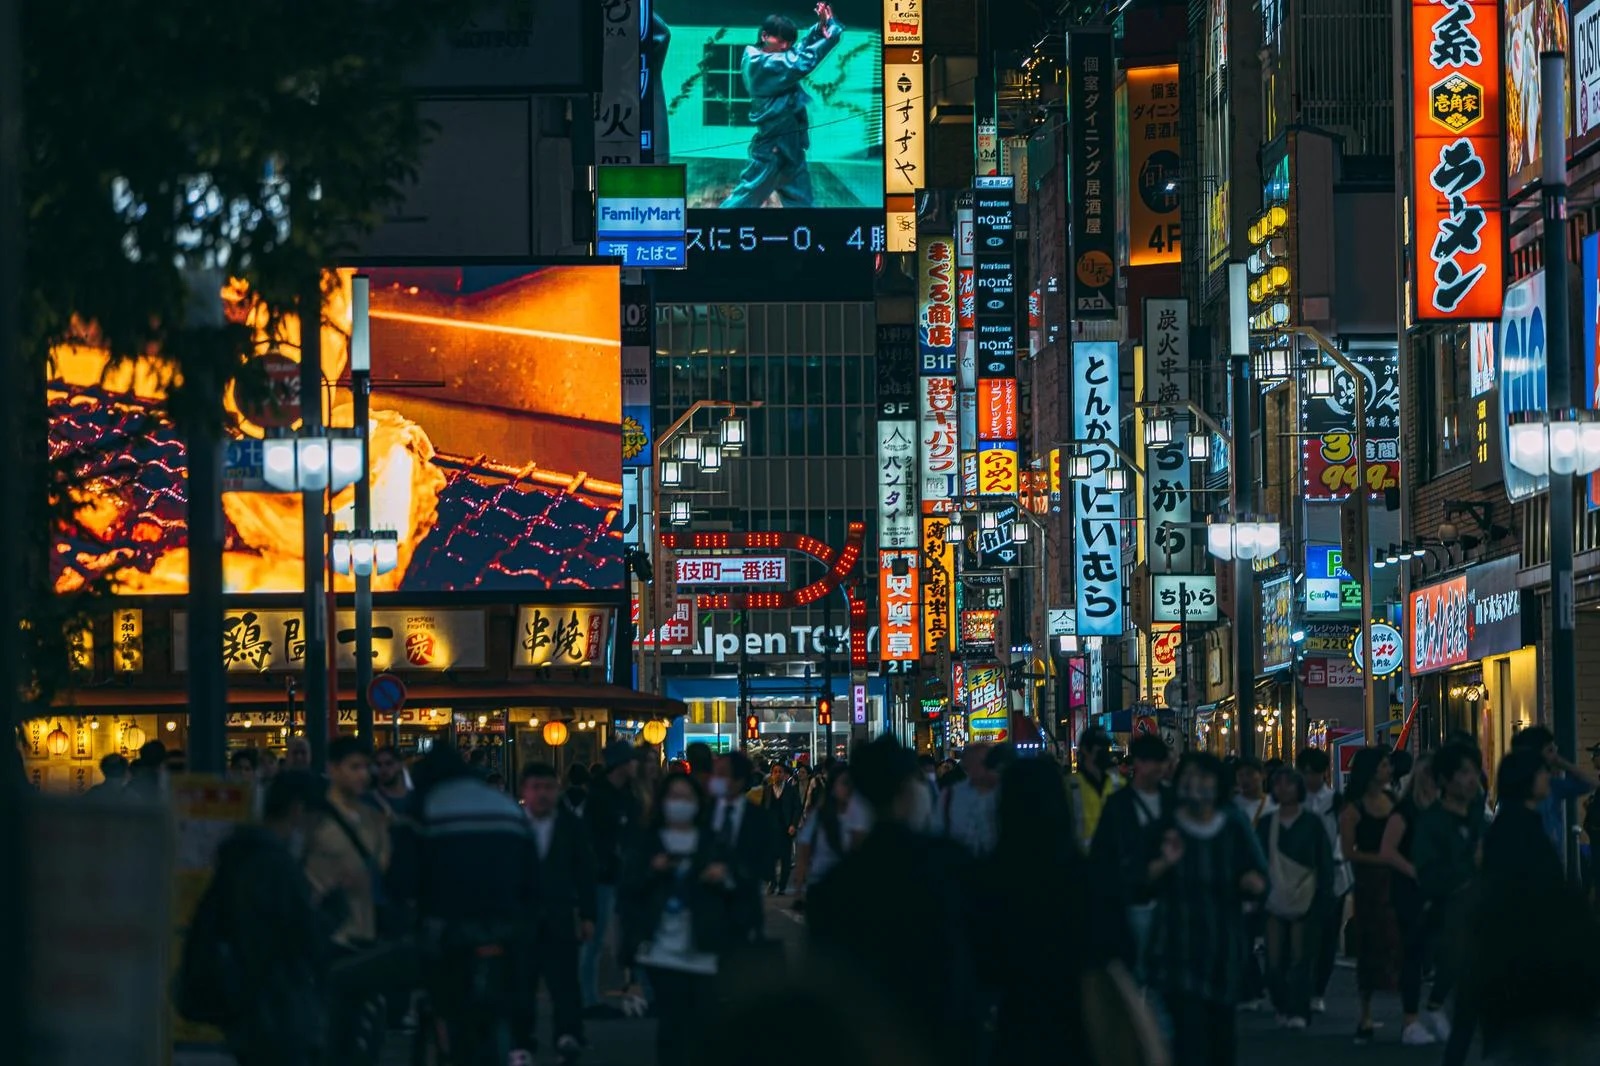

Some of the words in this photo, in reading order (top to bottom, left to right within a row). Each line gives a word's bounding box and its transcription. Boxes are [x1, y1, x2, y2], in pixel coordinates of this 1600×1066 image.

[911, 51, 919, 62] 5
[1151, 82, 1178, 100] 個室
[1435, 93, 1478, 112] 壱角家
[1133, 104, 1179, 120] ダイニン
[1083, 56, 1102, 234] 個室ダイニング居酒屋
[601, 206, 681, 223] FamilyMart
[1430, 138, 1486, 312] ラーメン
[1149, 223, 1181, 254] 4F
[636, 247, 678, 261] たばこ
[928, 242, 952, 346] まぐろ商店
[1082, 299, 1105, 309] 入口
[924, 354, 957, 369] B1F
[884, 402, 910, 415] 3F
[984, 451, 1012, 492] らーめん
[883, 456, 902, 523] バンタイ
[1080, 354, 1118, 619] とんかつにいむら
[1152, 442, 1187, 554] ちから
[1327, 550, 1342, 577] P
[1160, 588, 1216, 606] ちから
[522, 609, 584, 664] 串焼
[408, 634, 434, 660] 炭
[1360, 644, 1399, 656] ーメン
[888, 660, 912, 673] 2F
[1145, 667, 1172, 678] ビール
